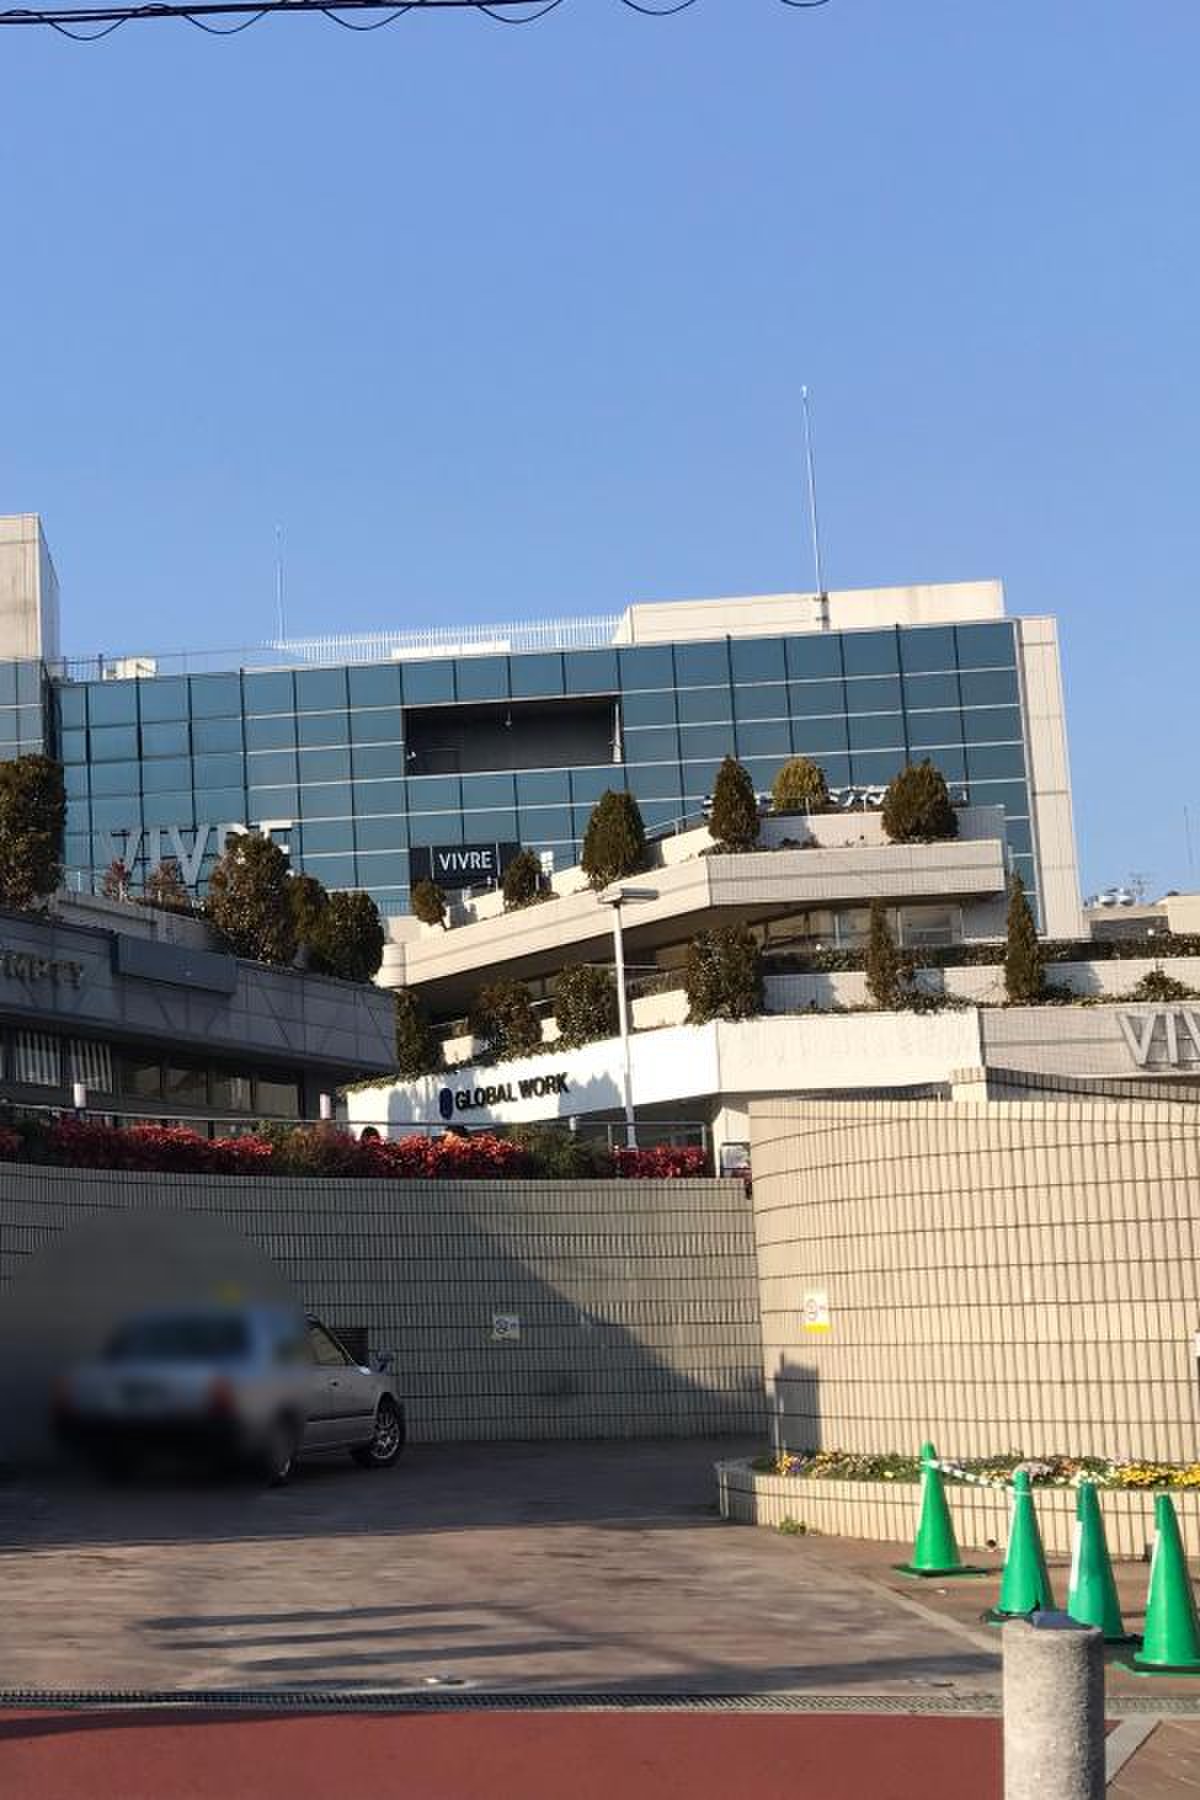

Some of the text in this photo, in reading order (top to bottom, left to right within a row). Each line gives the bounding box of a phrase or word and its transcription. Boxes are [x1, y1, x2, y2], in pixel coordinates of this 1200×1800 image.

[438, 850, 493, 871] VIVRE
[454, 1071, 570, 1110] GLOBAL WORK
